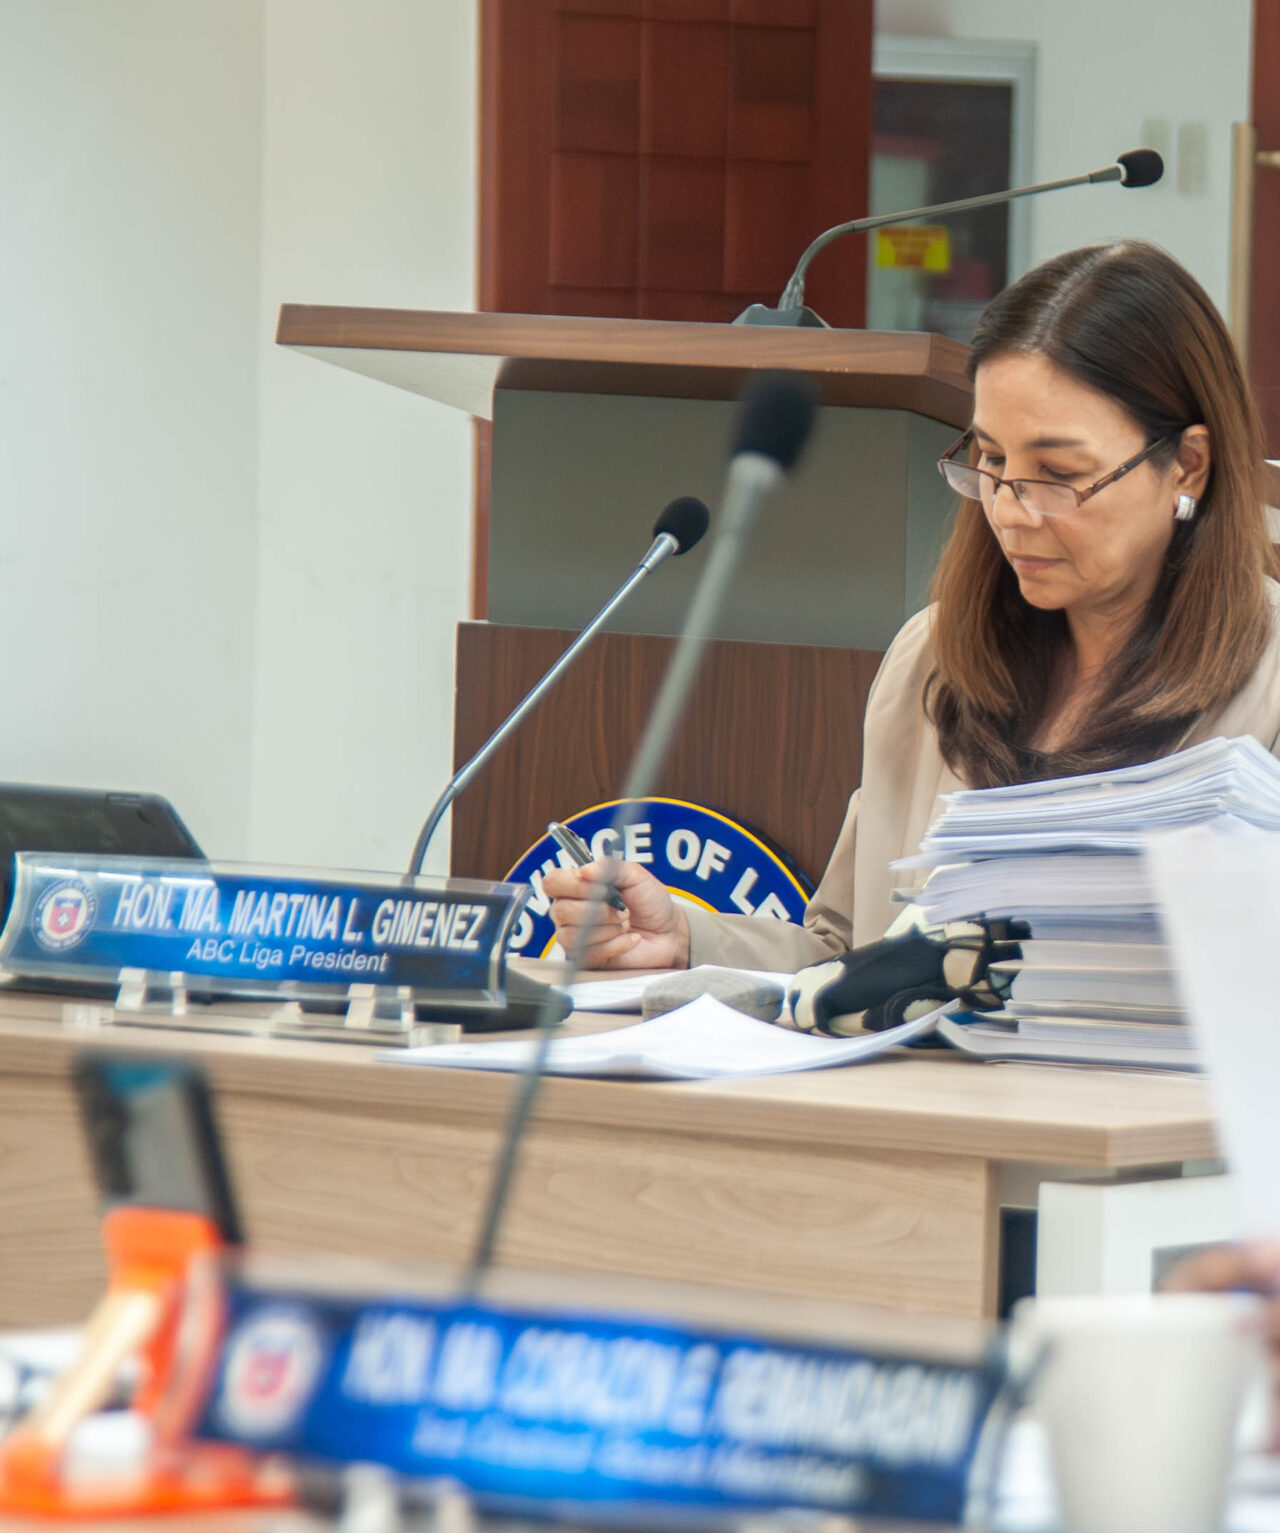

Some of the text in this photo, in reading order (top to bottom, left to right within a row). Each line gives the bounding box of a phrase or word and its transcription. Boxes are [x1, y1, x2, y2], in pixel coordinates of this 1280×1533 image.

[666, 828, 732, 880] OF
[113, 881, 173, 930] HON.
[178, 885, 222, 933] MA.
[228, 890, 341, 940] MARTINA
[342, 897, 364, 942] L.
[371, 898, 489, 949] GIMENEZ
[186, 938, 389, 973] ABC Liga President
